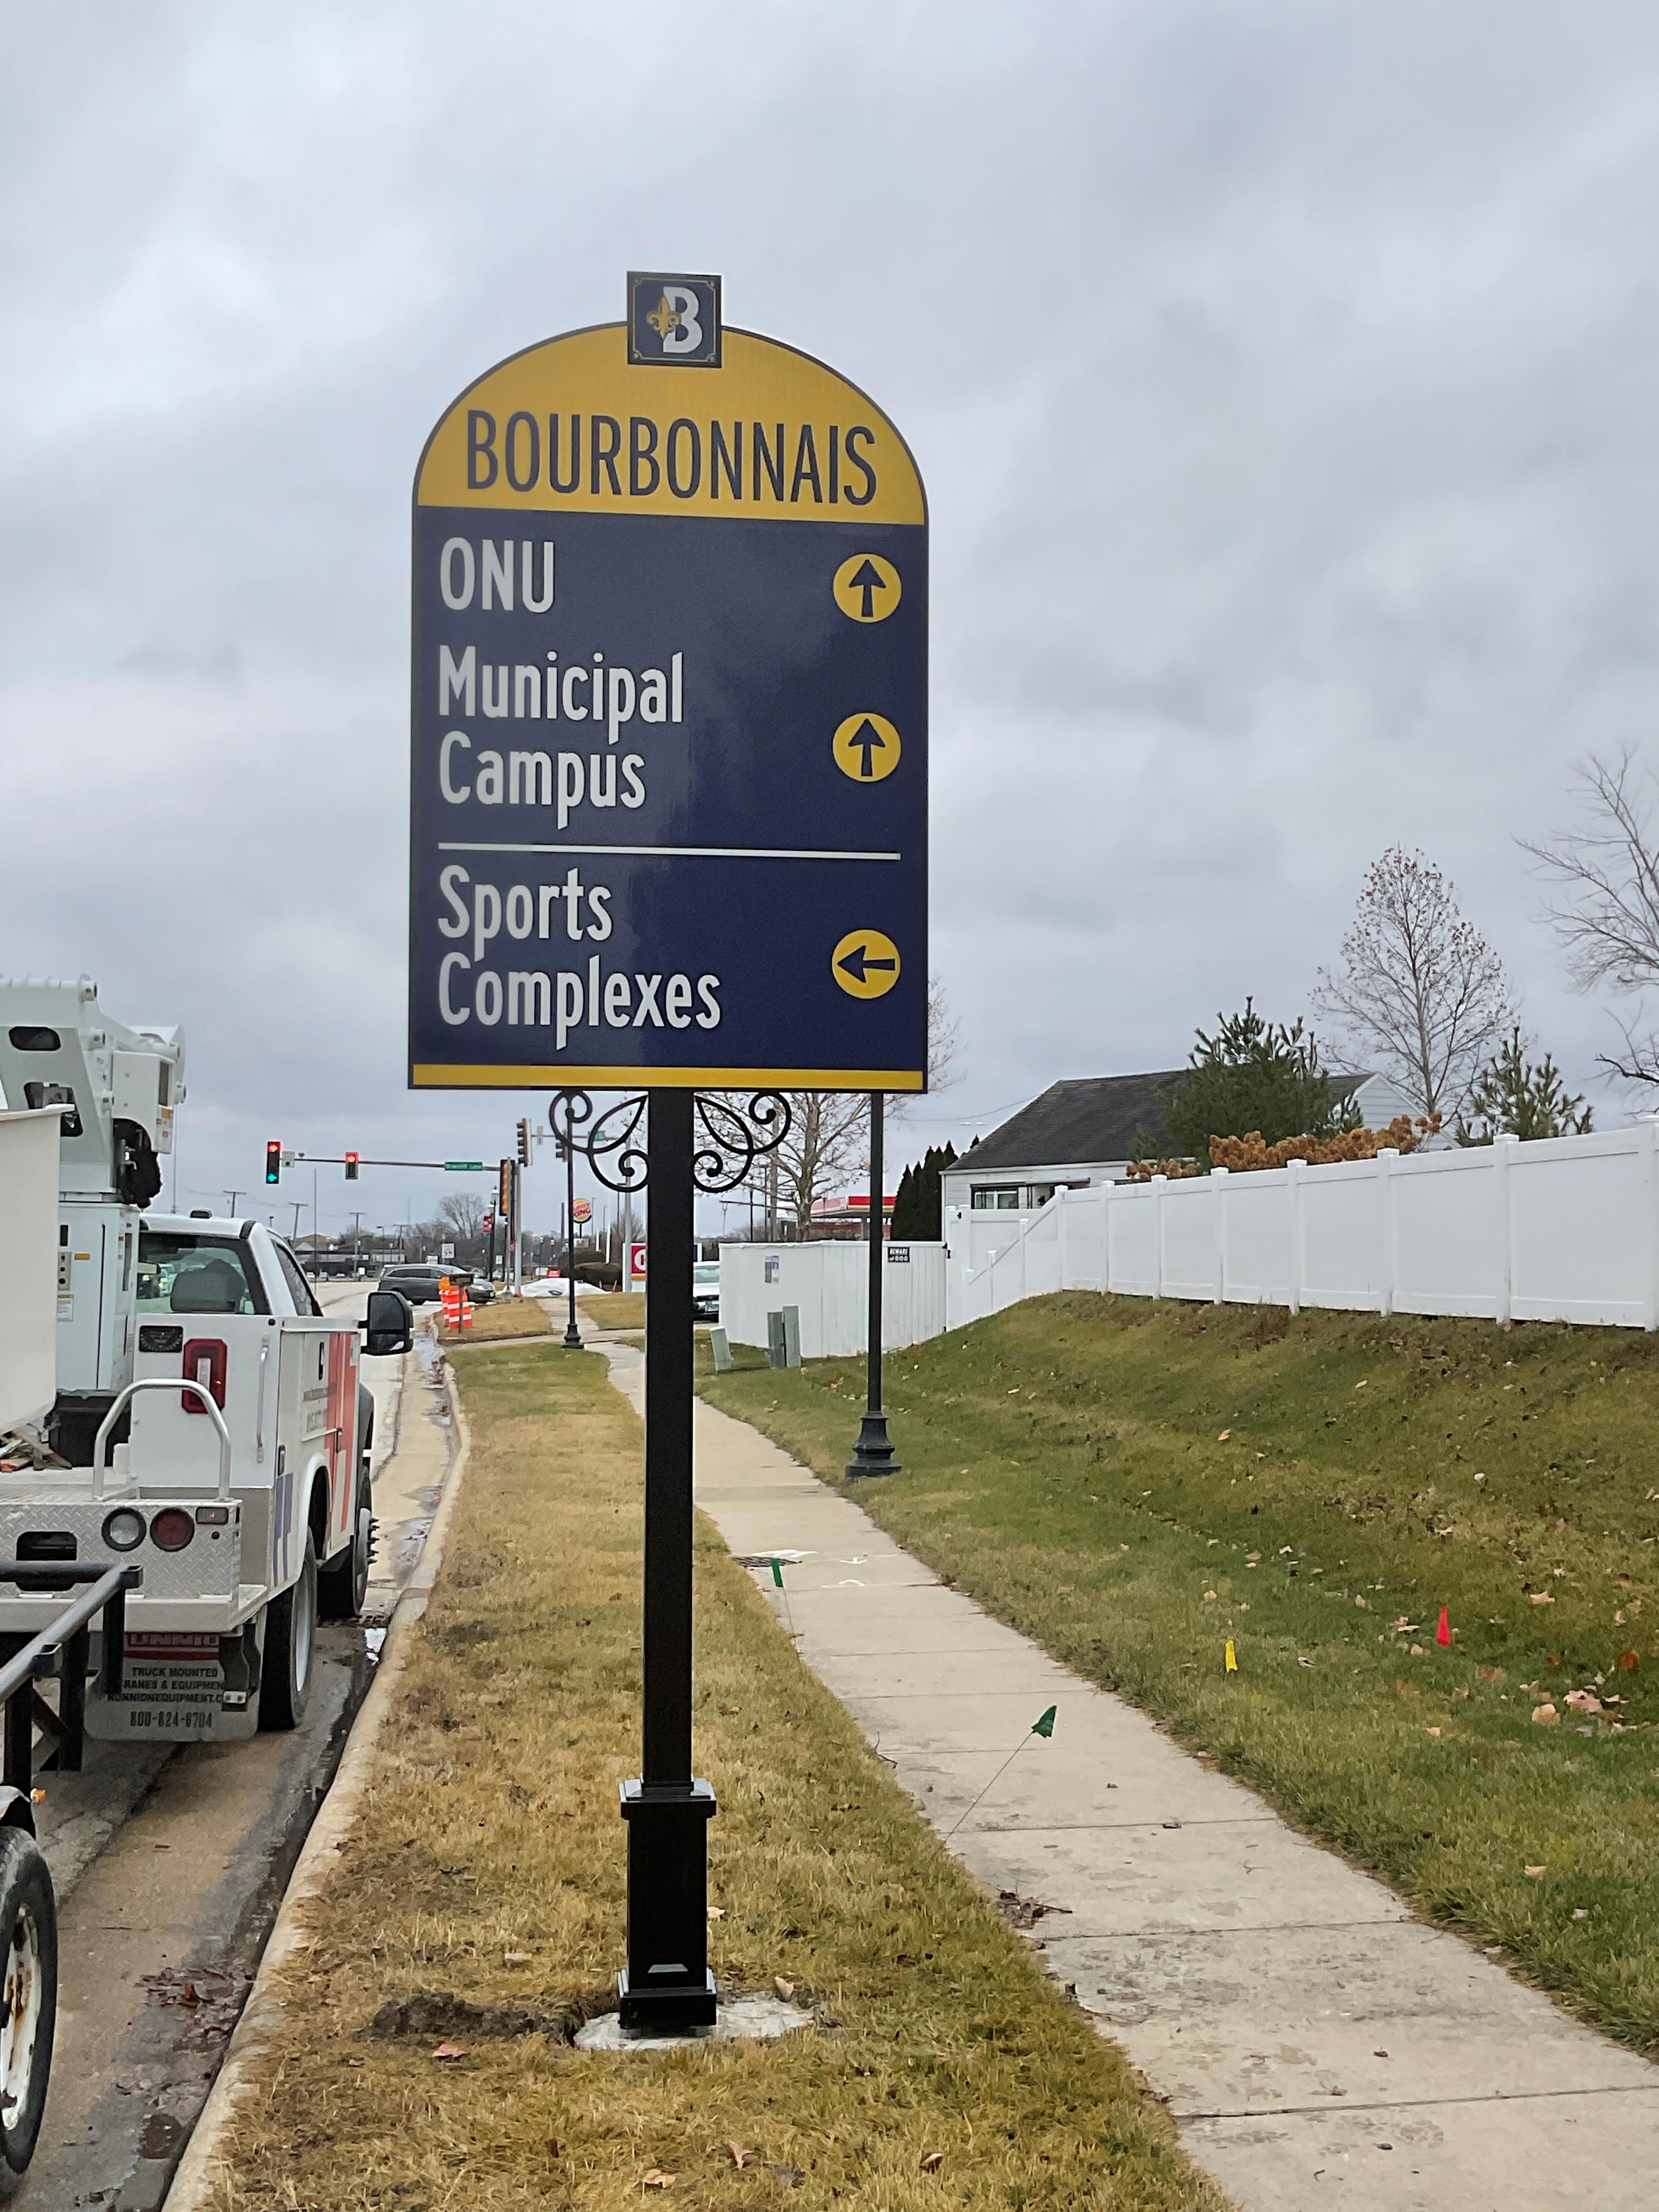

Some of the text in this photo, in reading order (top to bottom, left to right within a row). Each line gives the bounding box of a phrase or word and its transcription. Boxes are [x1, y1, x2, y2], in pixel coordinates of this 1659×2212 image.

[663, 286, 703, 353] B
[466, 410, 876, 506] BOURBONNAIS
[439, 537, 555, 613] ONU
[438, 645, 683, 744] Municipal
[439, 731, 646, 830] Campus
[438, 865, 613, 961] Sports
[438, 952, 721, 1051] Complexes
[123, 1679, 157, 1690] RANES
[171, 1680, 225, 1690] EQUIPMEN
[131, 1667, 218, 1678] TRUCK MOUNTED
